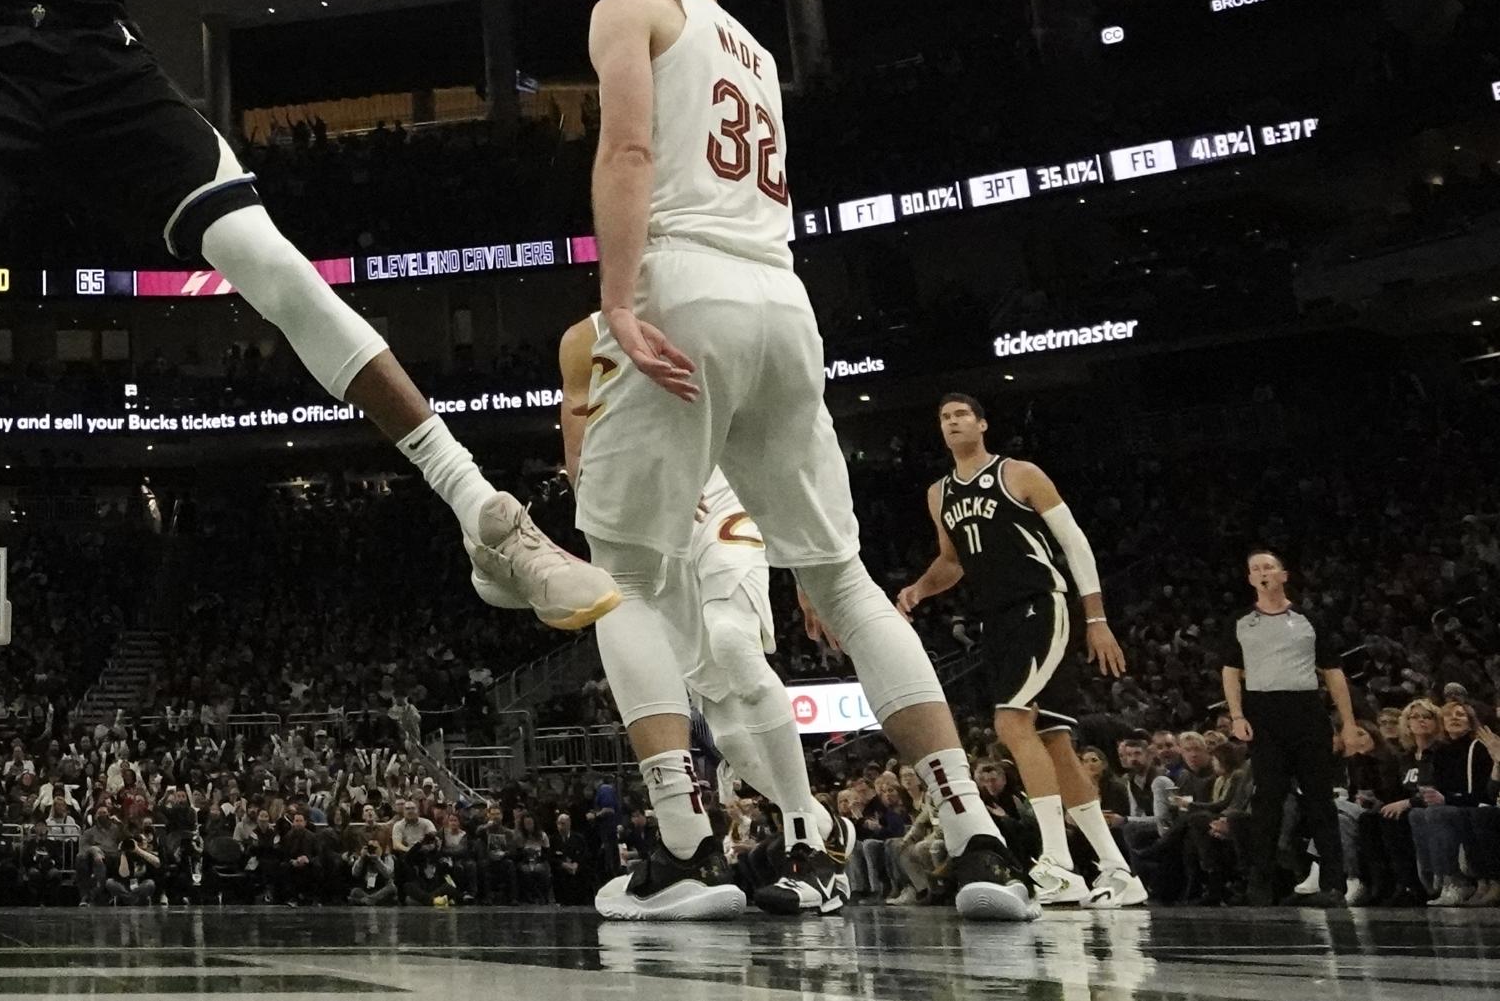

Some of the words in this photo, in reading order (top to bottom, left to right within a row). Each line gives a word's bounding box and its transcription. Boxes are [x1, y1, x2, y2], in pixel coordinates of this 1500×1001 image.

[714, 22, 763, 82] WADE
[1103, 29, 1123, 43] CC
[706, 77, 790, 208] 32
[76, 268, 105, 295] 65
[366, 247, 462, 281] CLEVELAND
[462, 240, 555, 272] CAVALIERS
[805, 214, 816, 233] 5
[856, 203, 877, 224] FT
[901, 187, 956, 215] 80.0%
[983, 176, 1016, 200] 3PT
[1037, 158, 1097, 189] 35.0%
[1130, 150, 1157, 171] FG
[1191, 130, 1250, 160] 41.8%
[1262, 121, 1300, 145] 8:37
[994, 320, 1138, 356] ticketmaster
[17, 414, 50, 429] and
[55, 414, 82, 429] sell
[87, 418, 124, 433] your
[129, 414, 178, 430] Bucks
[182, 414, 235, 429] tickets
[239, 412, 257, 426] at
[261, 409, 288, 425] the
[292, 404, 354, 423] Official
[470, 396, 488, 410] of
[492, 393, 522, 409] the
[943, 496, 998, 531] BUCKS
[962, 522, 983, 555] 11
